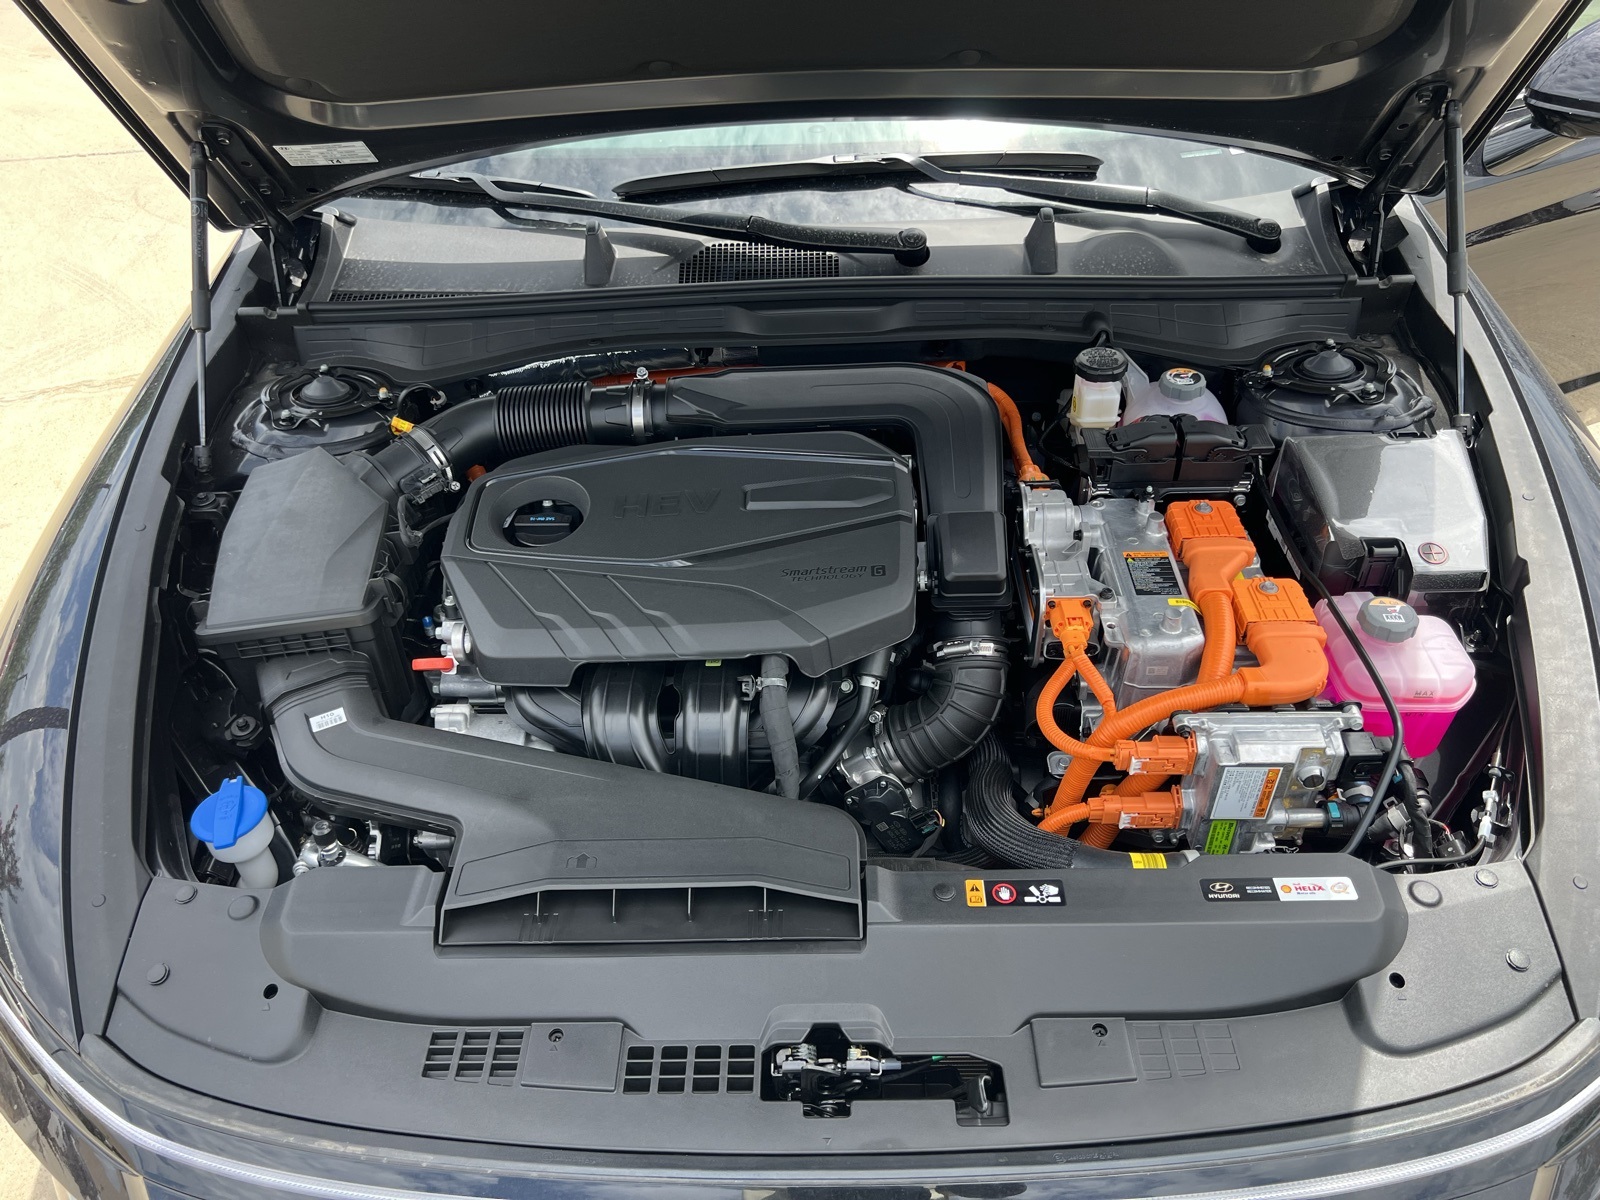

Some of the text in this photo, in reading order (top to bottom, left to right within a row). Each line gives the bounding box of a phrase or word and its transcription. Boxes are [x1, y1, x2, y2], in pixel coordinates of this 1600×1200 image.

[613, 488, 722, 519] HEV
[781, 565, 867, 577] Smartstream
[791, 573, 865, 582] TECHNOLOGY
